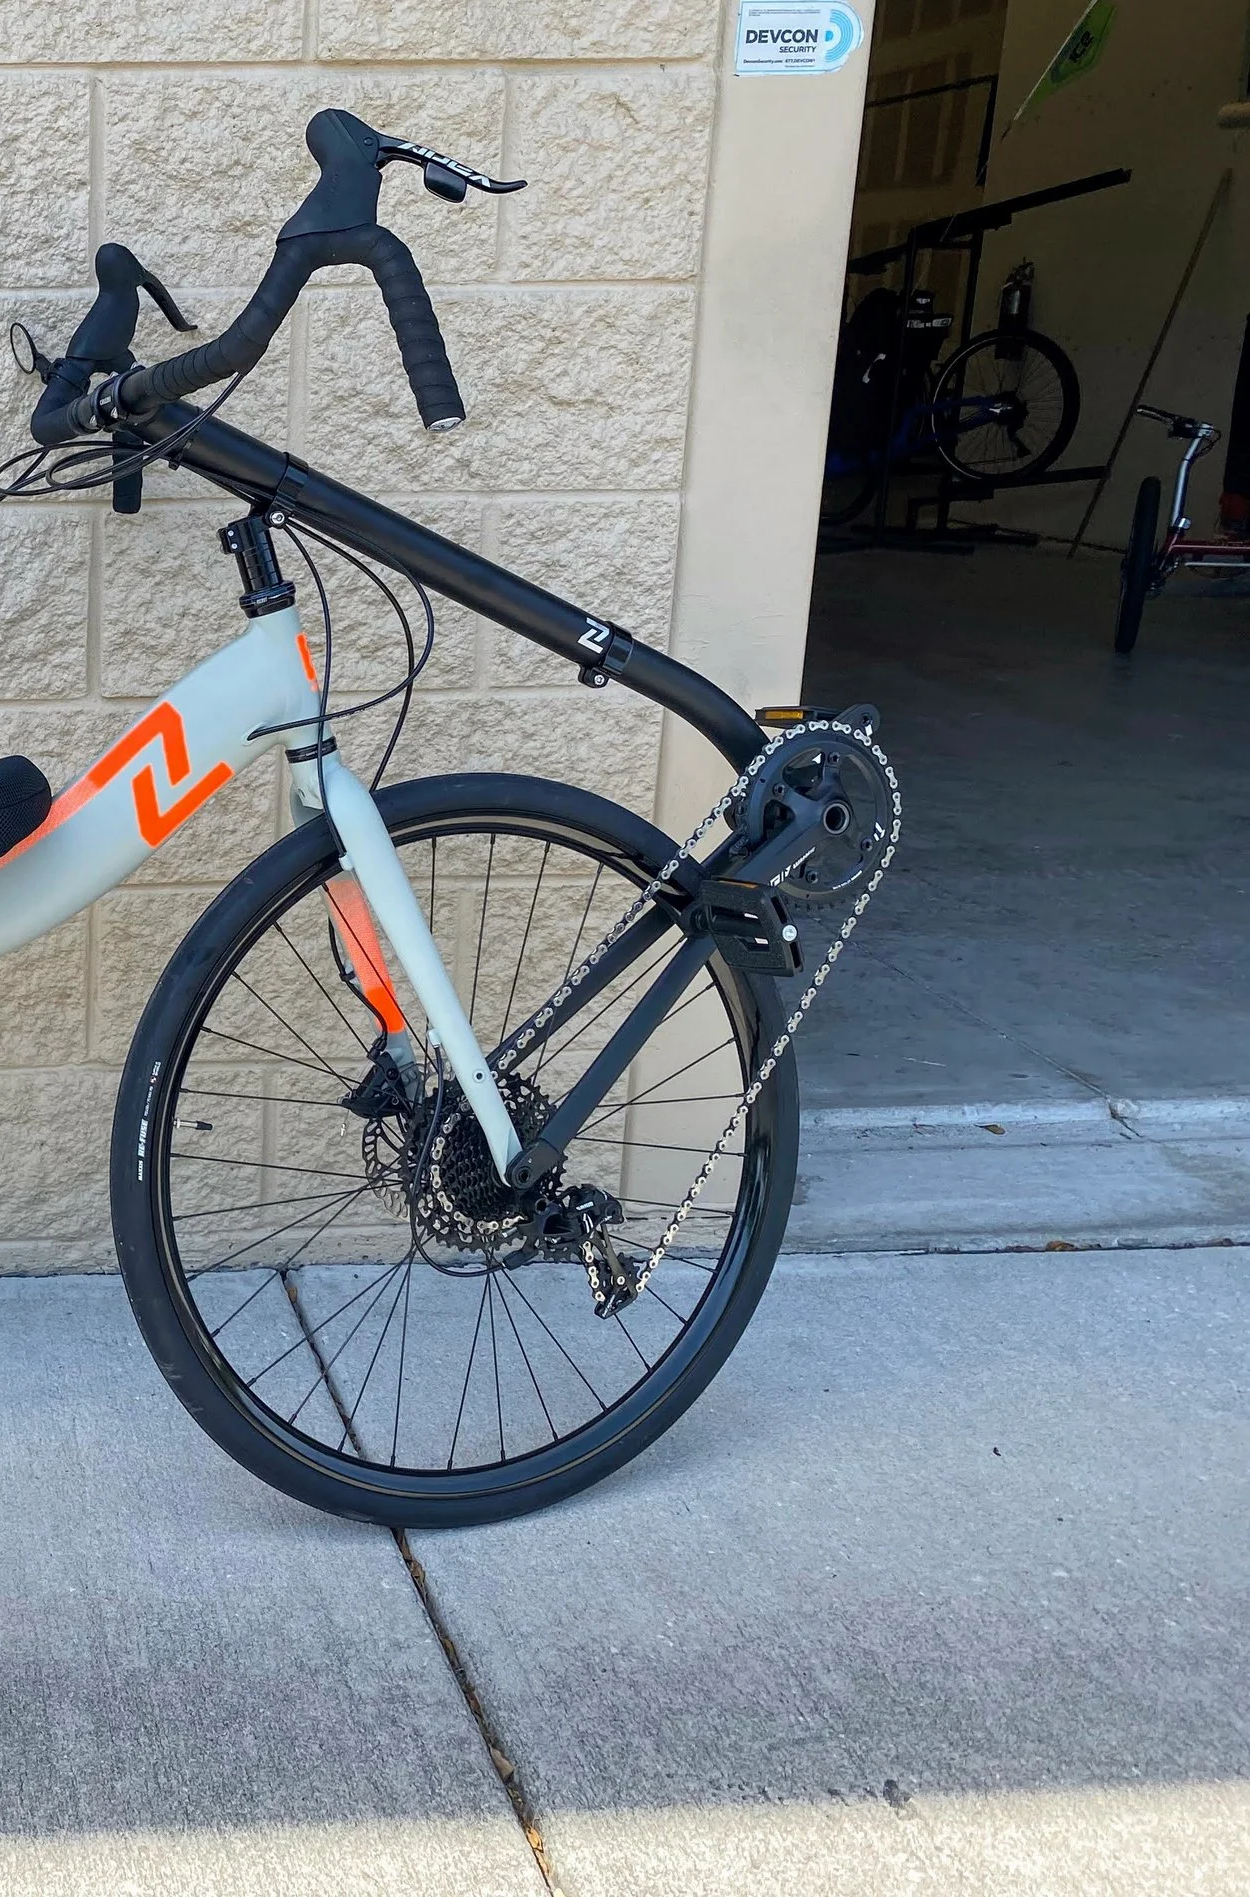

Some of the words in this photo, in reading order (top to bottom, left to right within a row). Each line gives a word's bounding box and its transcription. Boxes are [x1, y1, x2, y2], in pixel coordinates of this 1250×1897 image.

[745, 29, 819, 44] DEVCON
[779, 46, 817, 54] SECURITY
[137, 1118, 149, 1158] RE-FUSE
